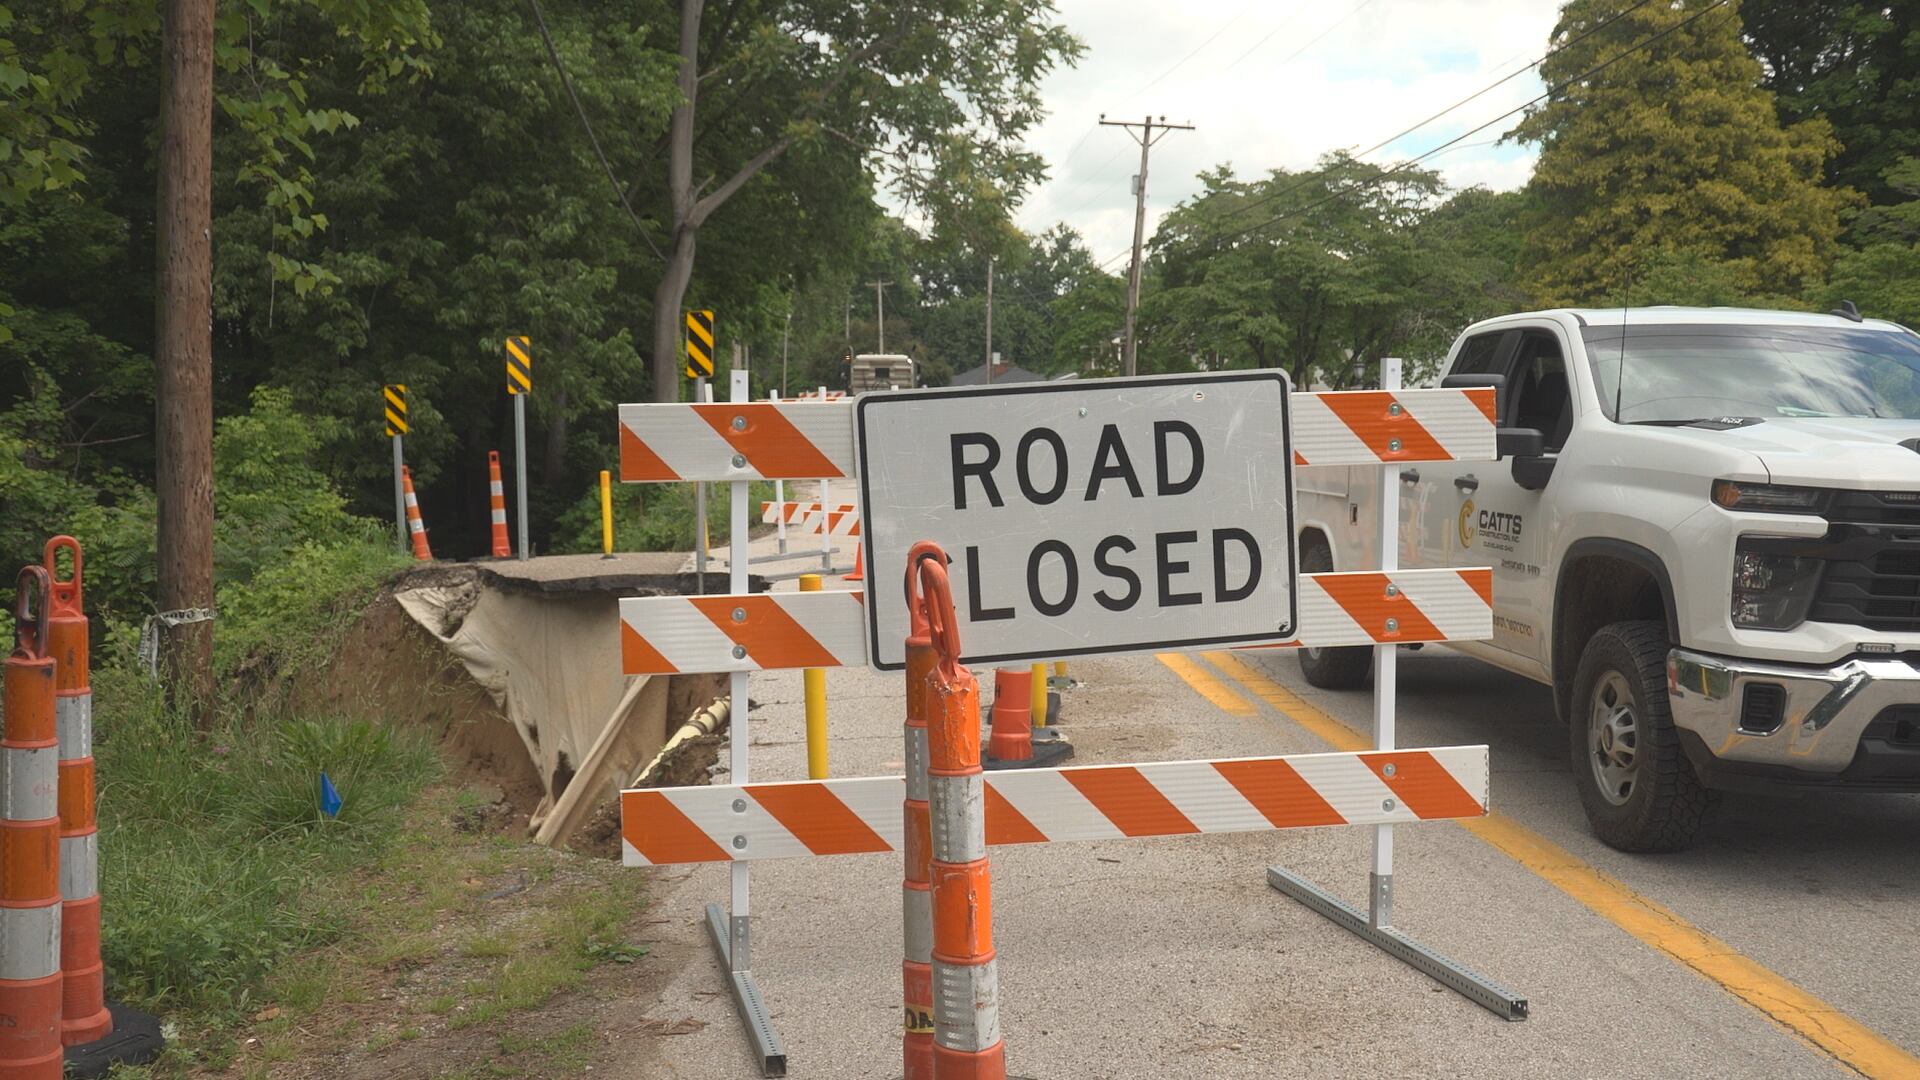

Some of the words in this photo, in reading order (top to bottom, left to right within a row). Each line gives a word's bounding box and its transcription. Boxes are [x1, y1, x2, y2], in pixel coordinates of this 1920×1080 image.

[950, 420, 1205, 510] ROAD
[1479, 510, 1522, 535] CATTS
[905, 527, 1262, 622] LOSED
